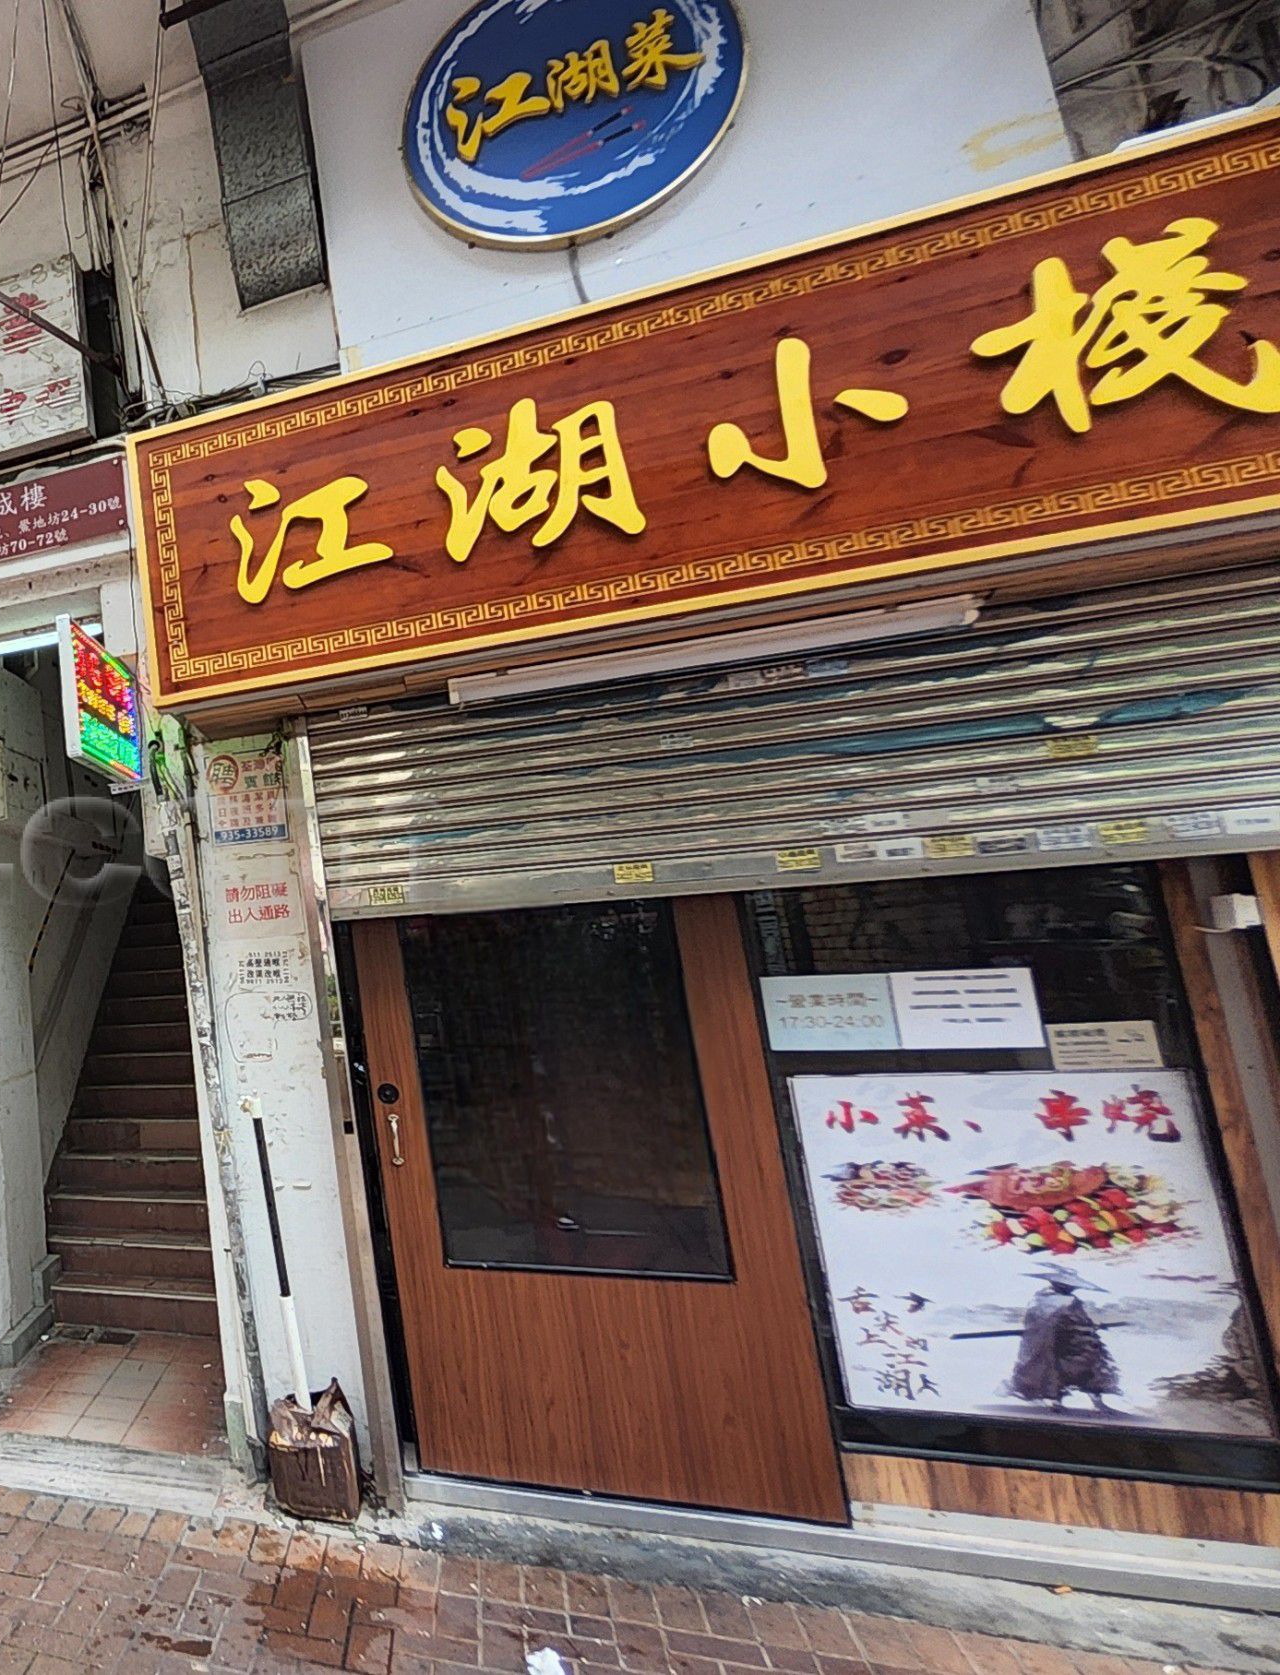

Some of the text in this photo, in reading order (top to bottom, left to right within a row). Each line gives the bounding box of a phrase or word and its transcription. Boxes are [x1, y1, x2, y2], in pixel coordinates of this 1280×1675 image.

[446, 8, 706, 163] 江湖菜
[220, 826, 279, 840] 935-33589
[225, 881, 288, 903] 請勿阻礙
[227, 904, 290, 924] 出入通路
